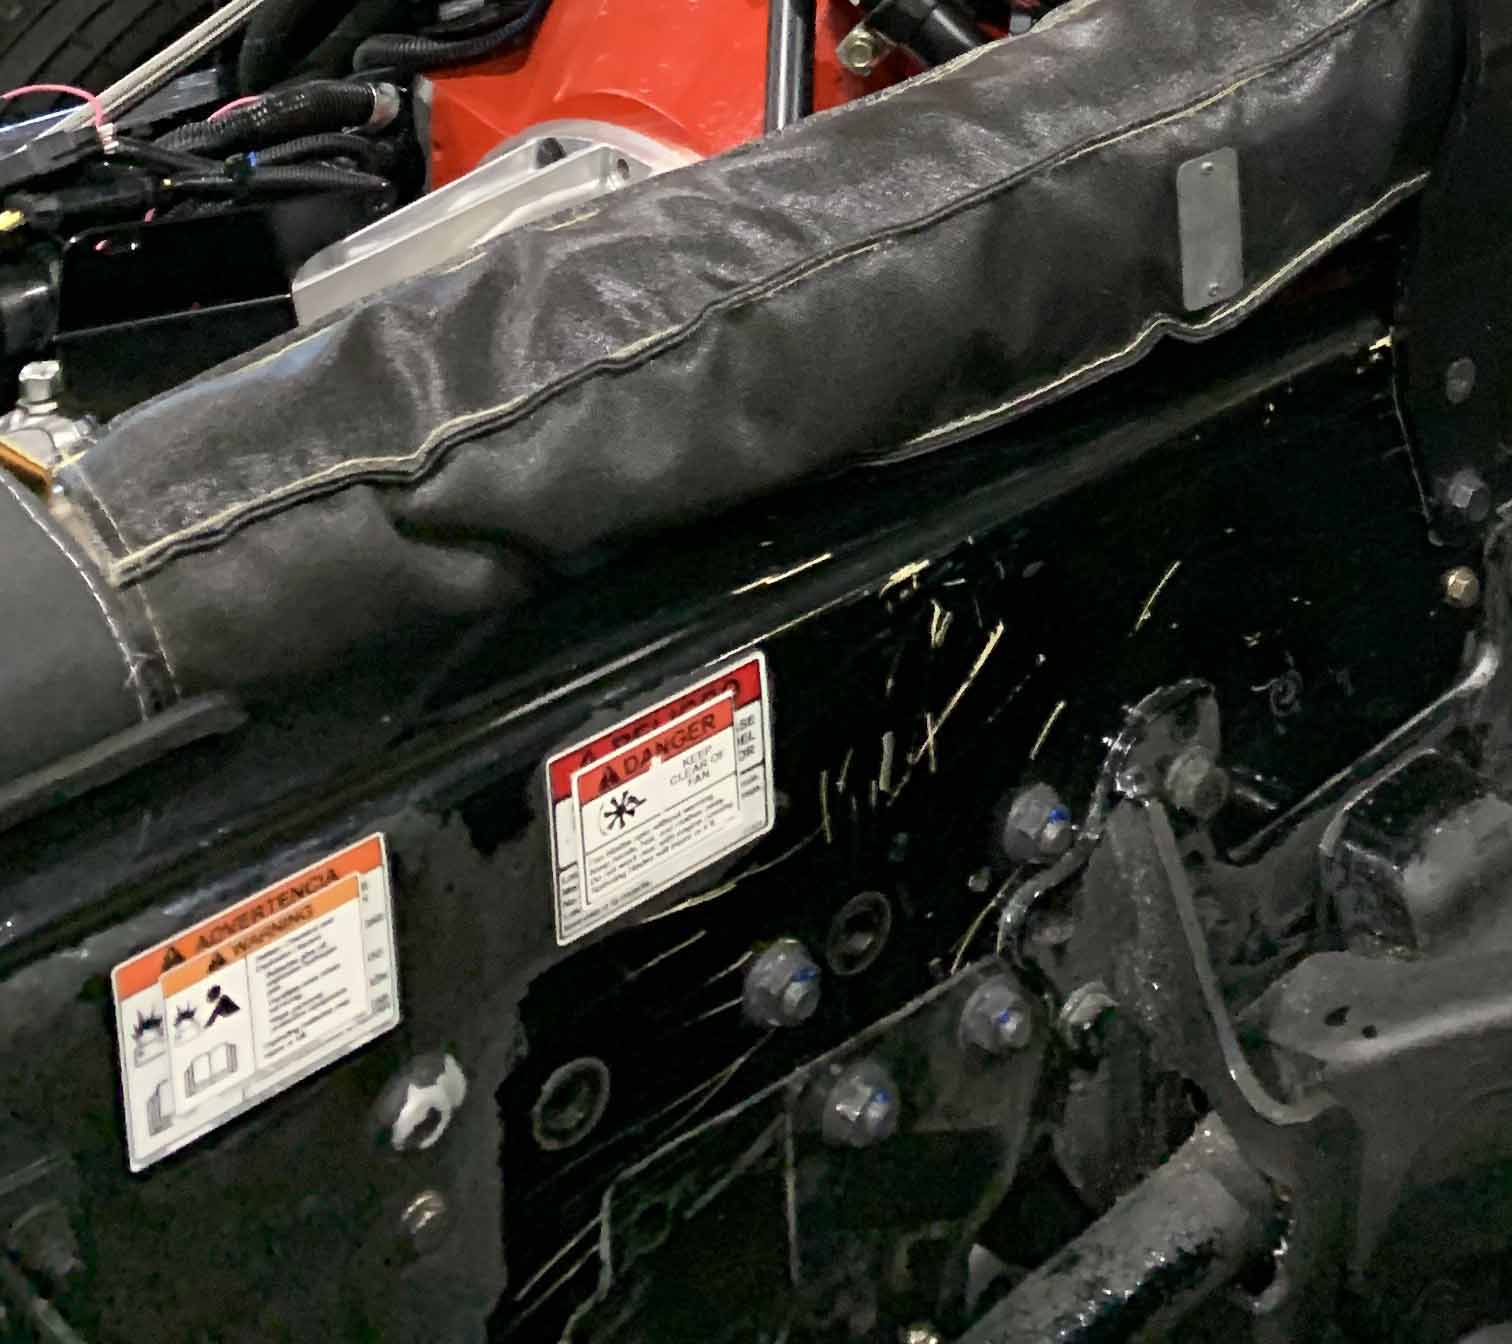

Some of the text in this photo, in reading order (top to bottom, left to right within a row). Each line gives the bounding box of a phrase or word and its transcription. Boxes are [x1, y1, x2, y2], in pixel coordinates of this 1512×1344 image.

[623, 714, 716, 775] DANGER
[682, 745, 712, 768] KEEP
[669, 759, 707, 785] CLEAR
[688, 770, 711, 787] FAN
[198, 868, 340, 950] ADVERTENCIA
[233, 904, 313, 955] WARNING
